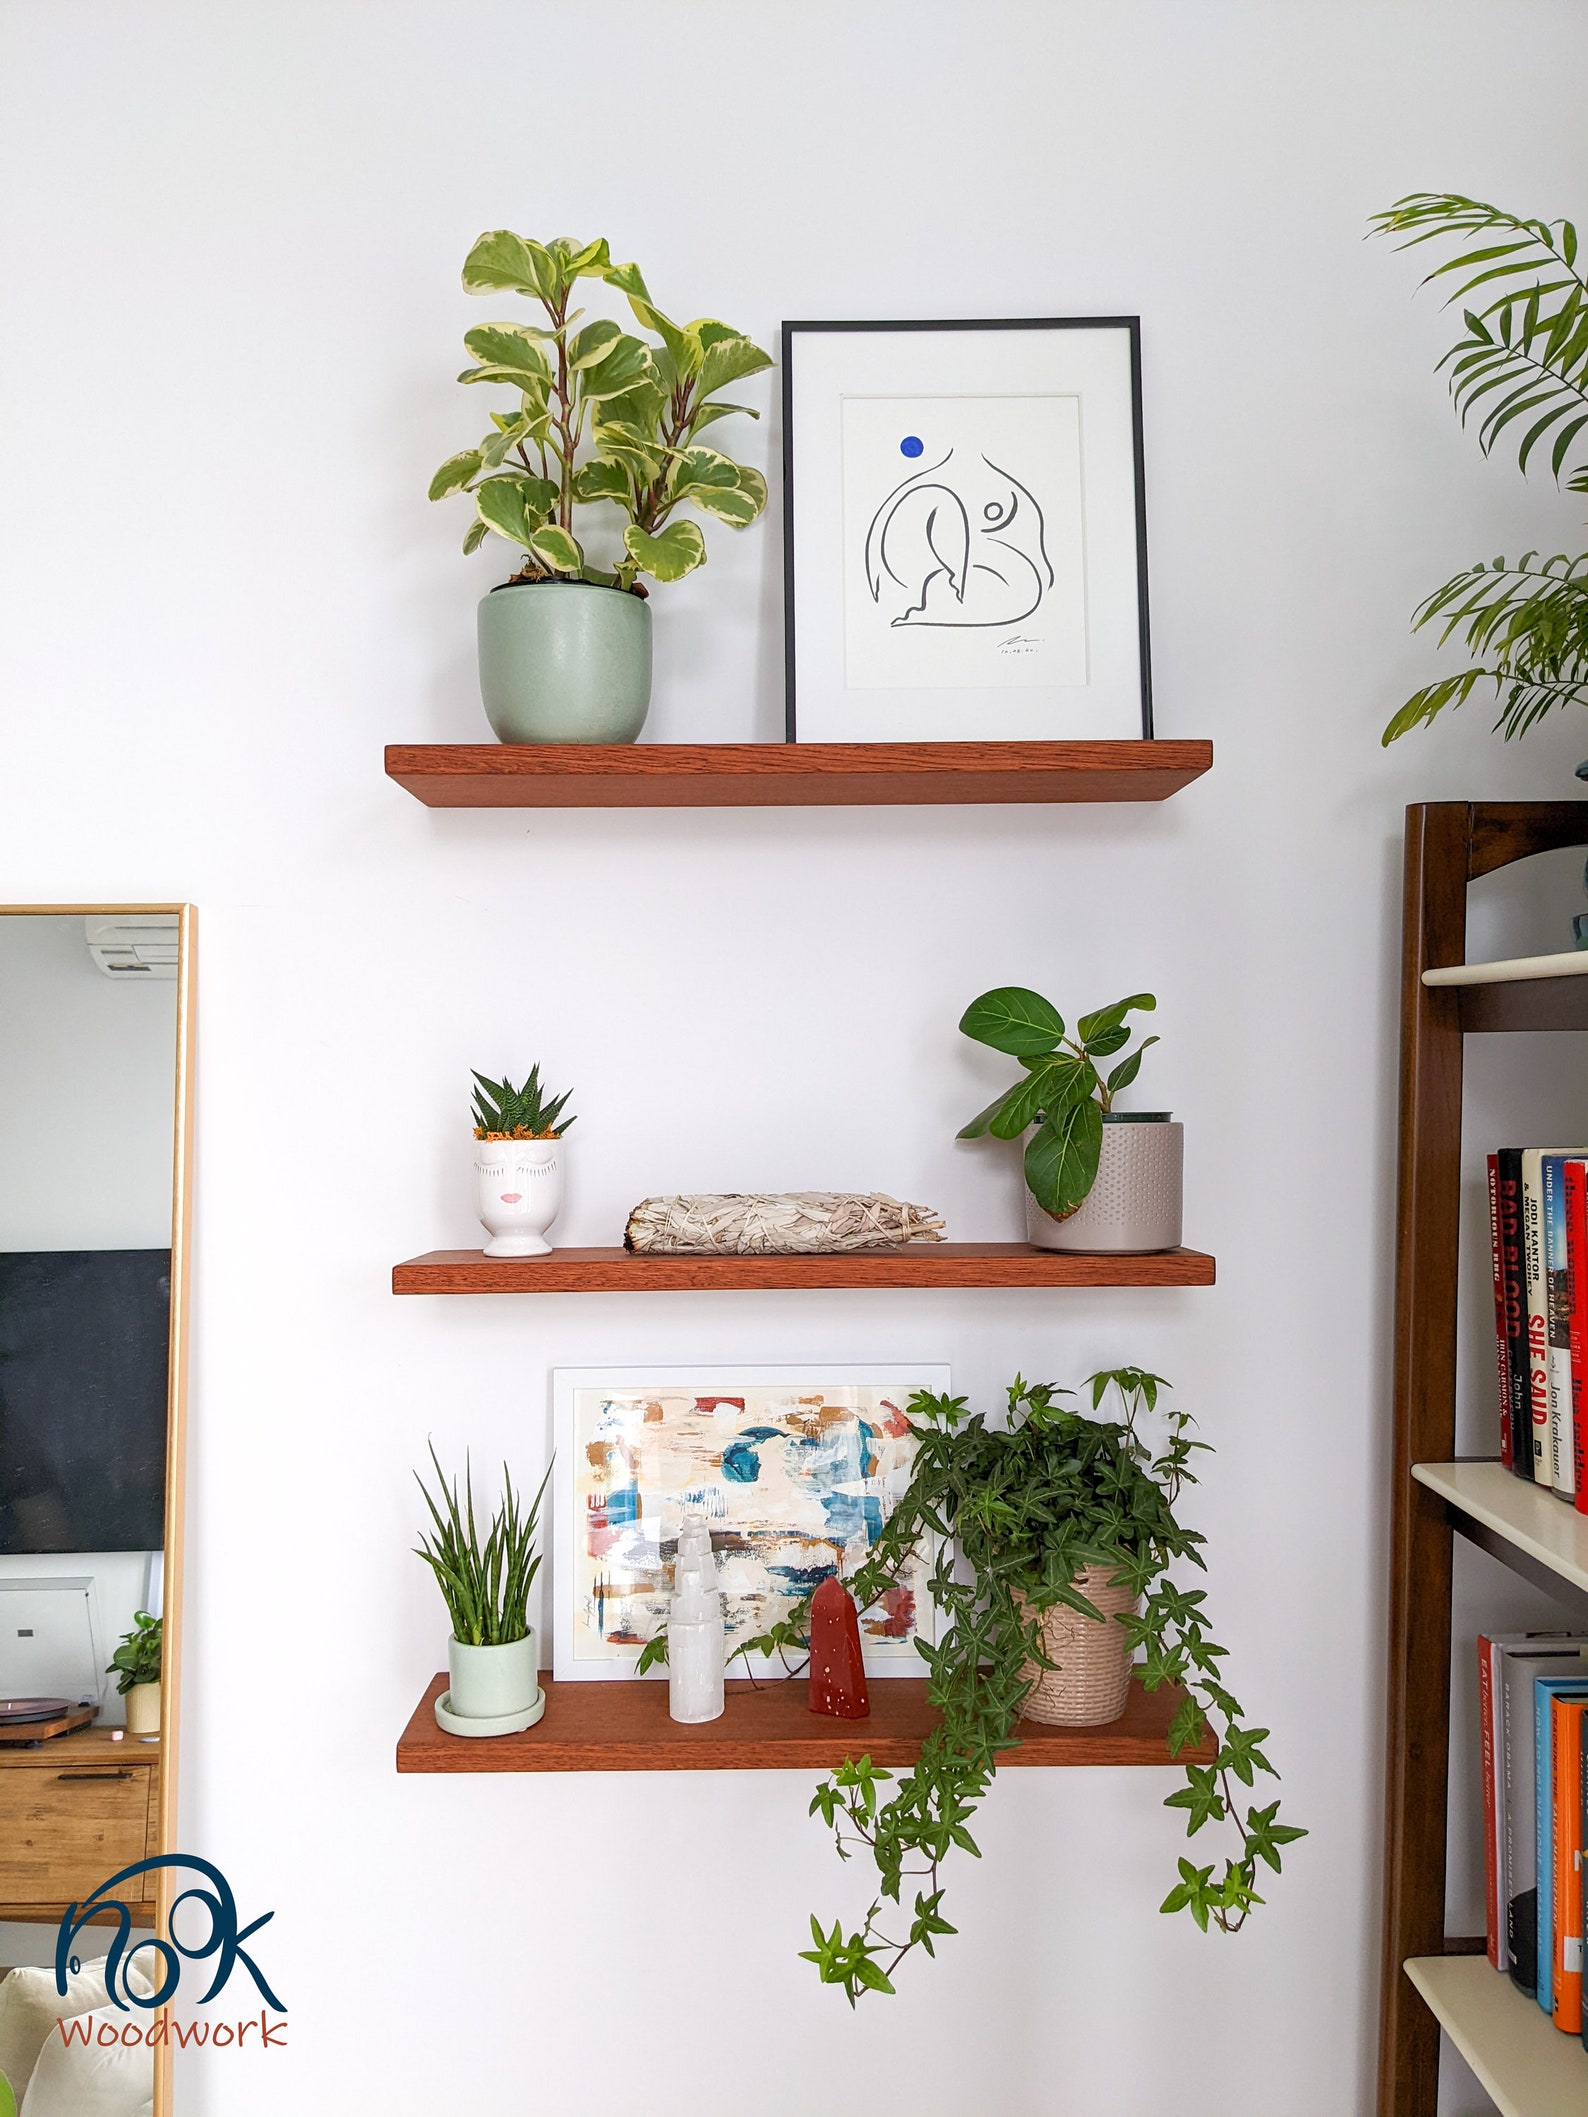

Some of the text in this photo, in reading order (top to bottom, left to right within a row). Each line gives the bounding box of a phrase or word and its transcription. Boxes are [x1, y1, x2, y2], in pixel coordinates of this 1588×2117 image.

[1489, 1168, 1498, 1248] NOTORIOUS
[1500, 1180, 1518, 1236] BAD
[1524, 1182, 1530, 1192] &
[1530, 1198, 1540, 1281] JODI KANTOR
[1548, 1276, 1555, 1290] OF
[1528, 1313, 1546, 1362] SHE
[1500, 1363, 1508, 1406] CARMON
[1513, 1374, 1523, 1409] John
[1531, 1368, 1549, 1425] SAID
[1551, 1382, 1561, 1408] Jon
[1551, 1410, 1563, 1479] Krakauer
